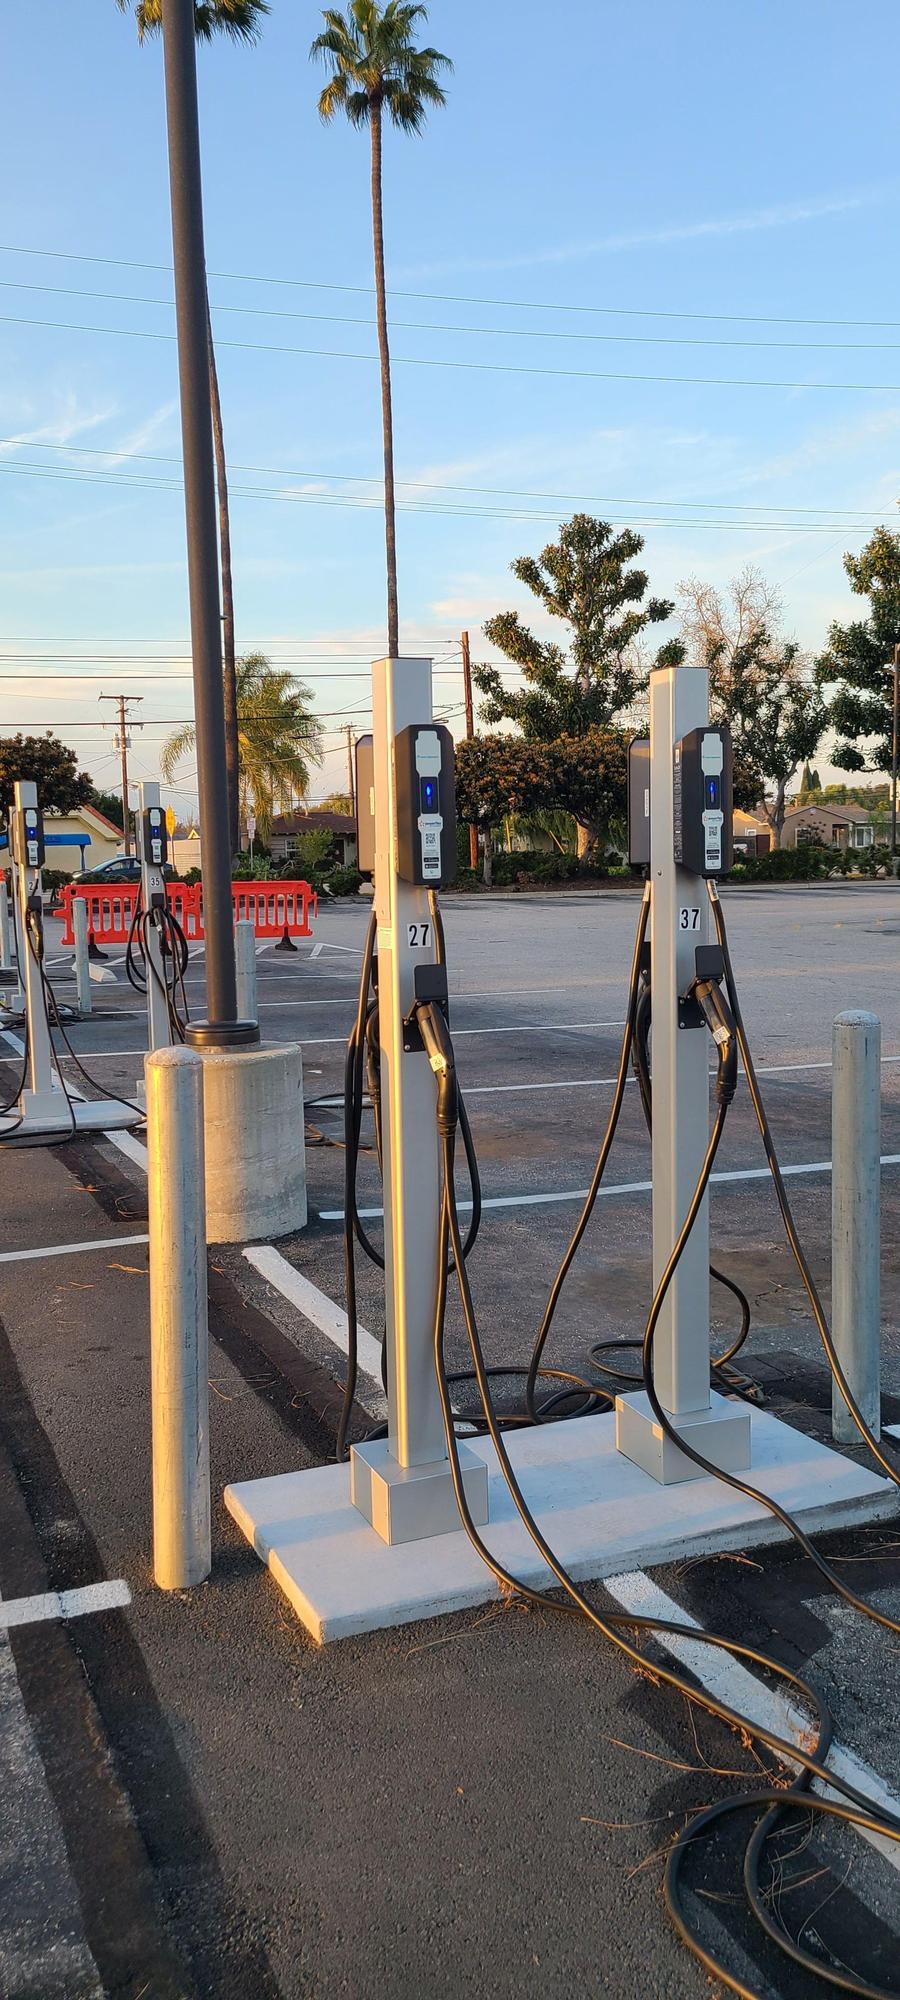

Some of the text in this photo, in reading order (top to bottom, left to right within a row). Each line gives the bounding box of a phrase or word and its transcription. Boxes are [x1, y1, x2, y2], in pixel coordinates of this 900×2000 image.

[150, 877, 160, 886] 35
[681, 908, 700, 929] 37
[409, 924, 429, 946] 27
